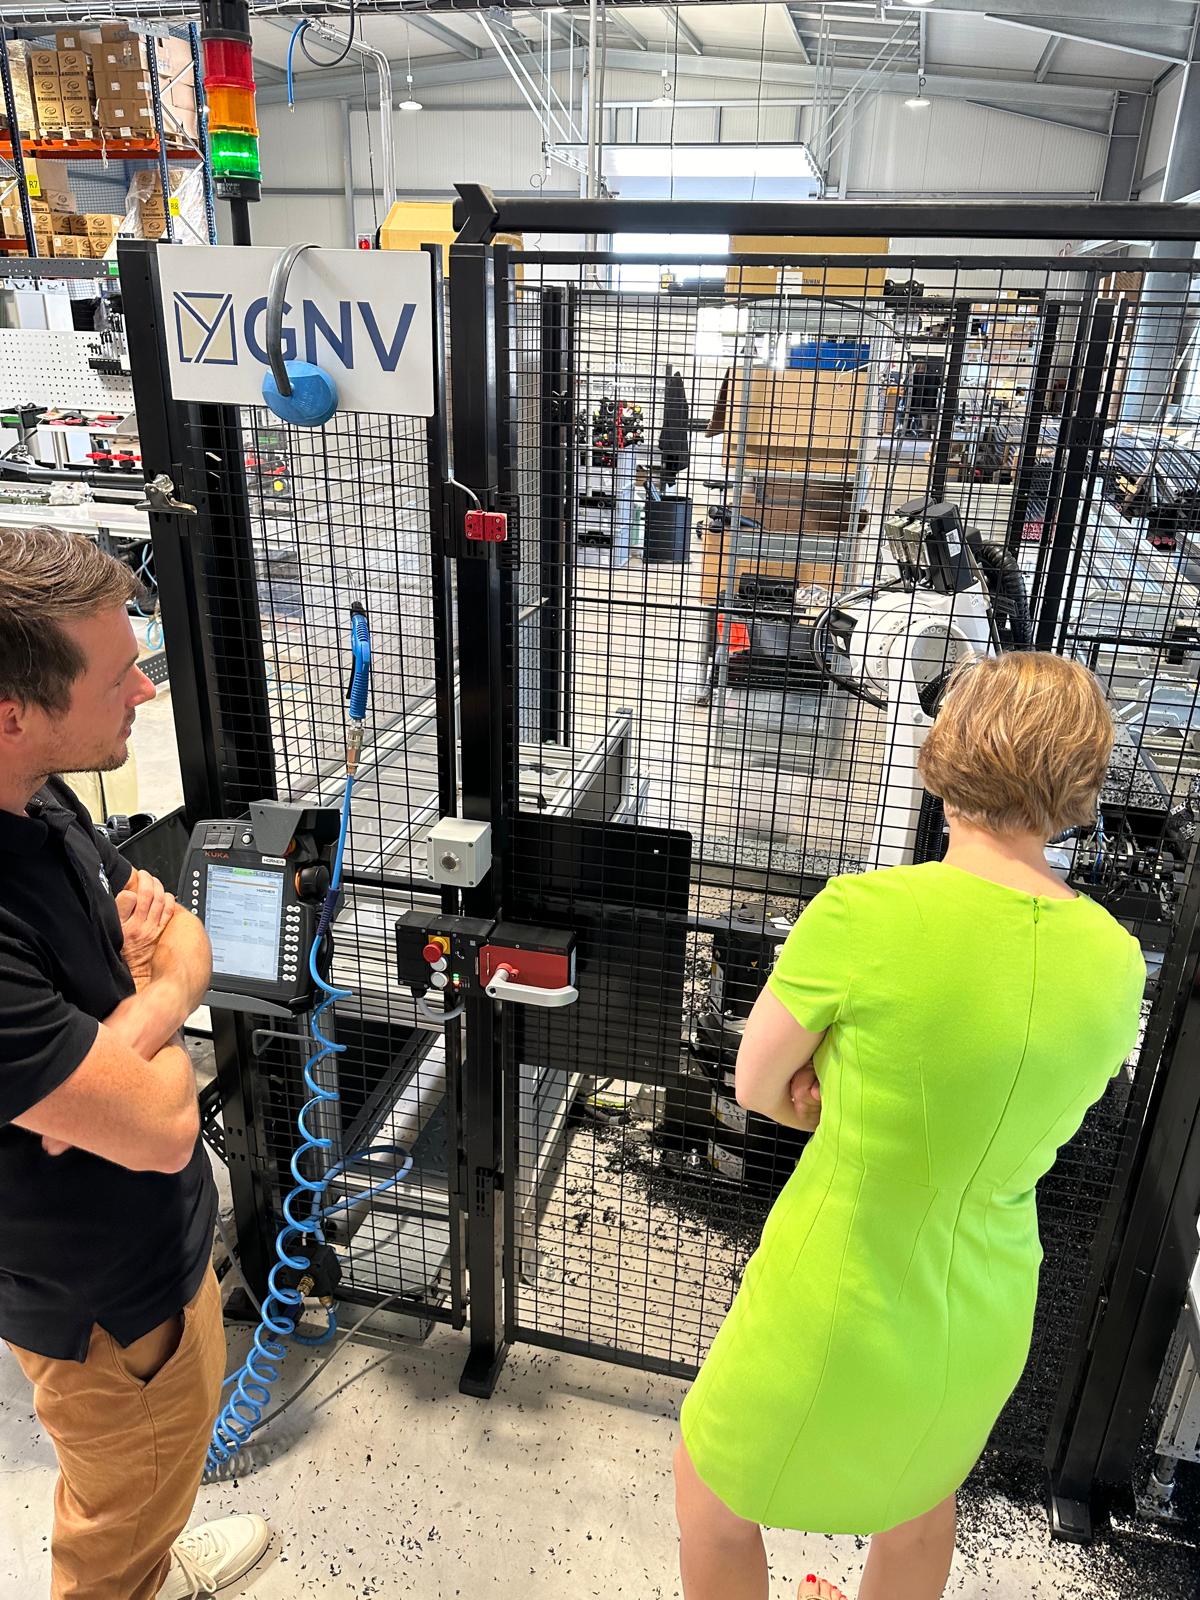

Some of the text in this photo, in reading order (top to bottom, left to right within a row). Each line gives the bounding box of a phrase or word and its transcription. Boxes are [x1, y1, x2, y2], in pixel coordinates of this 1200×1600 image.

[29, 180, 38, 189] R7
[244, 296, 417, 372] GNV
[204, 850, 230, 859] KUKA
